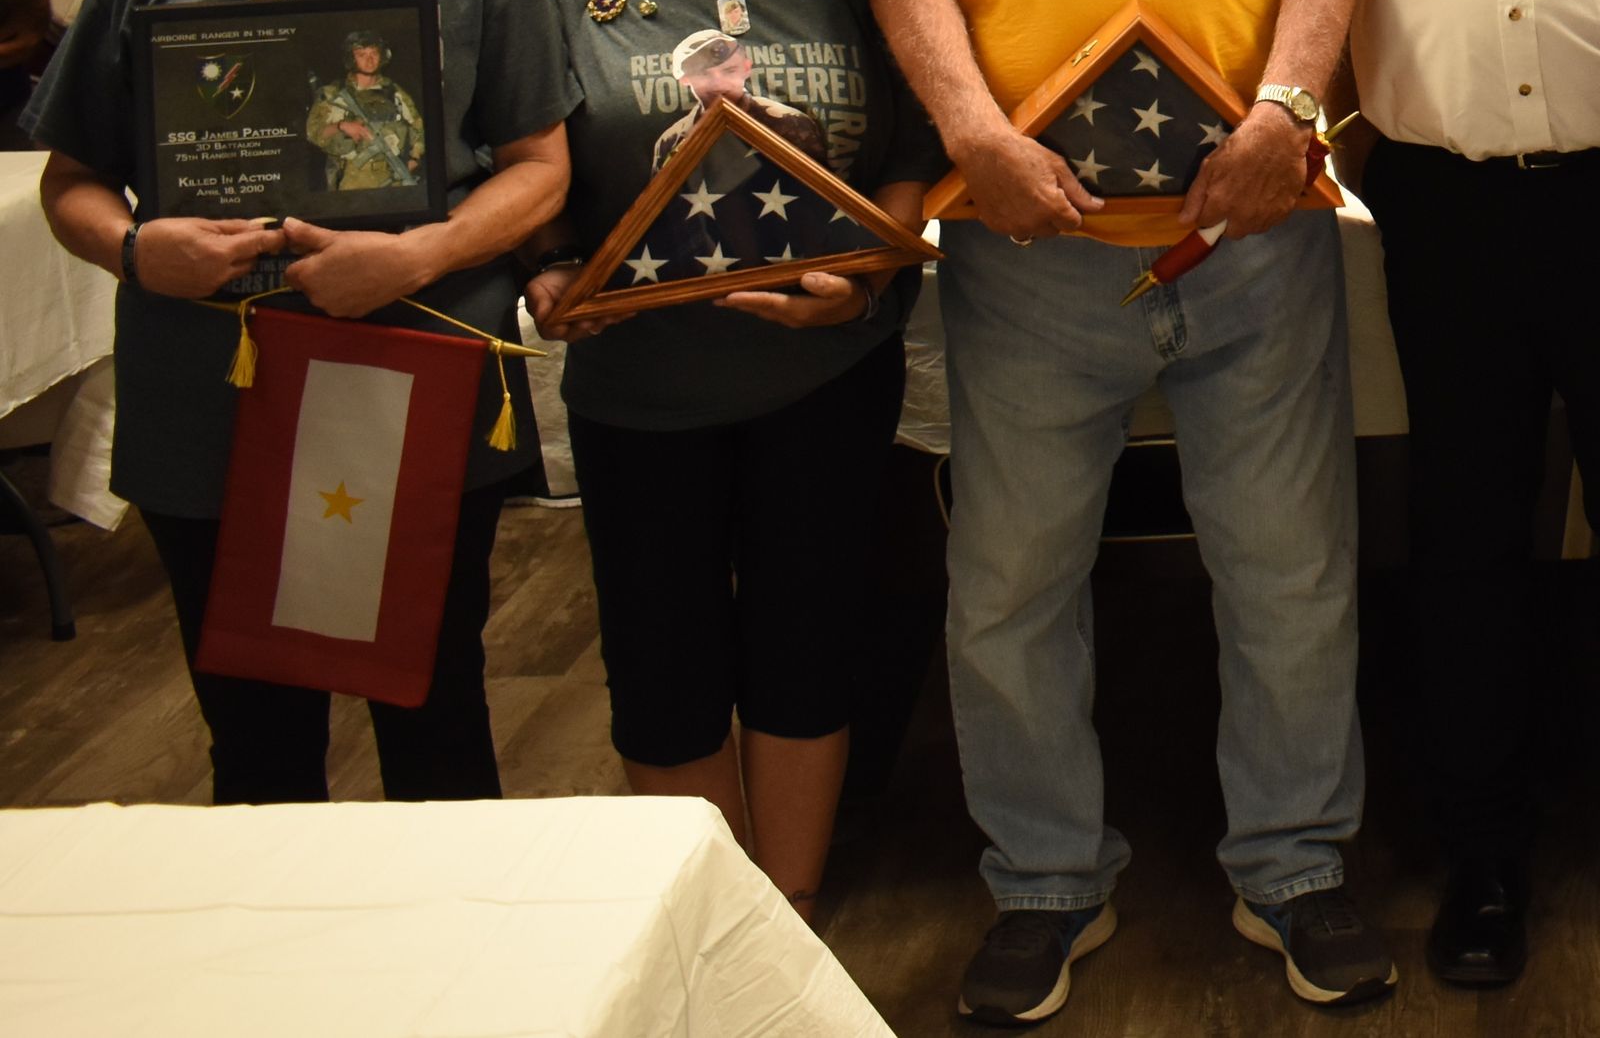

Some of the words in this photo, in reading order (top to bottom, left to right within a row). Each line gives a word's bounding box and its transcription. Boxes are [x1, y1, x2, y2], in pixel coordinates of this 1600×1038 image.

[151, 33, 197, 43] AIRBORNE
[201, 31, 240, 40] RANGER
[256, 28, 275, 36] THE
[278, 27, 297, 35] SKY
[790, 42, 847, 67] THAT
[853, 45, 861, 69] I
[168, 131, 197, 143] SSG
[195, 143, 211, 152] 3D
[240, 184, 265, 194] 2010
